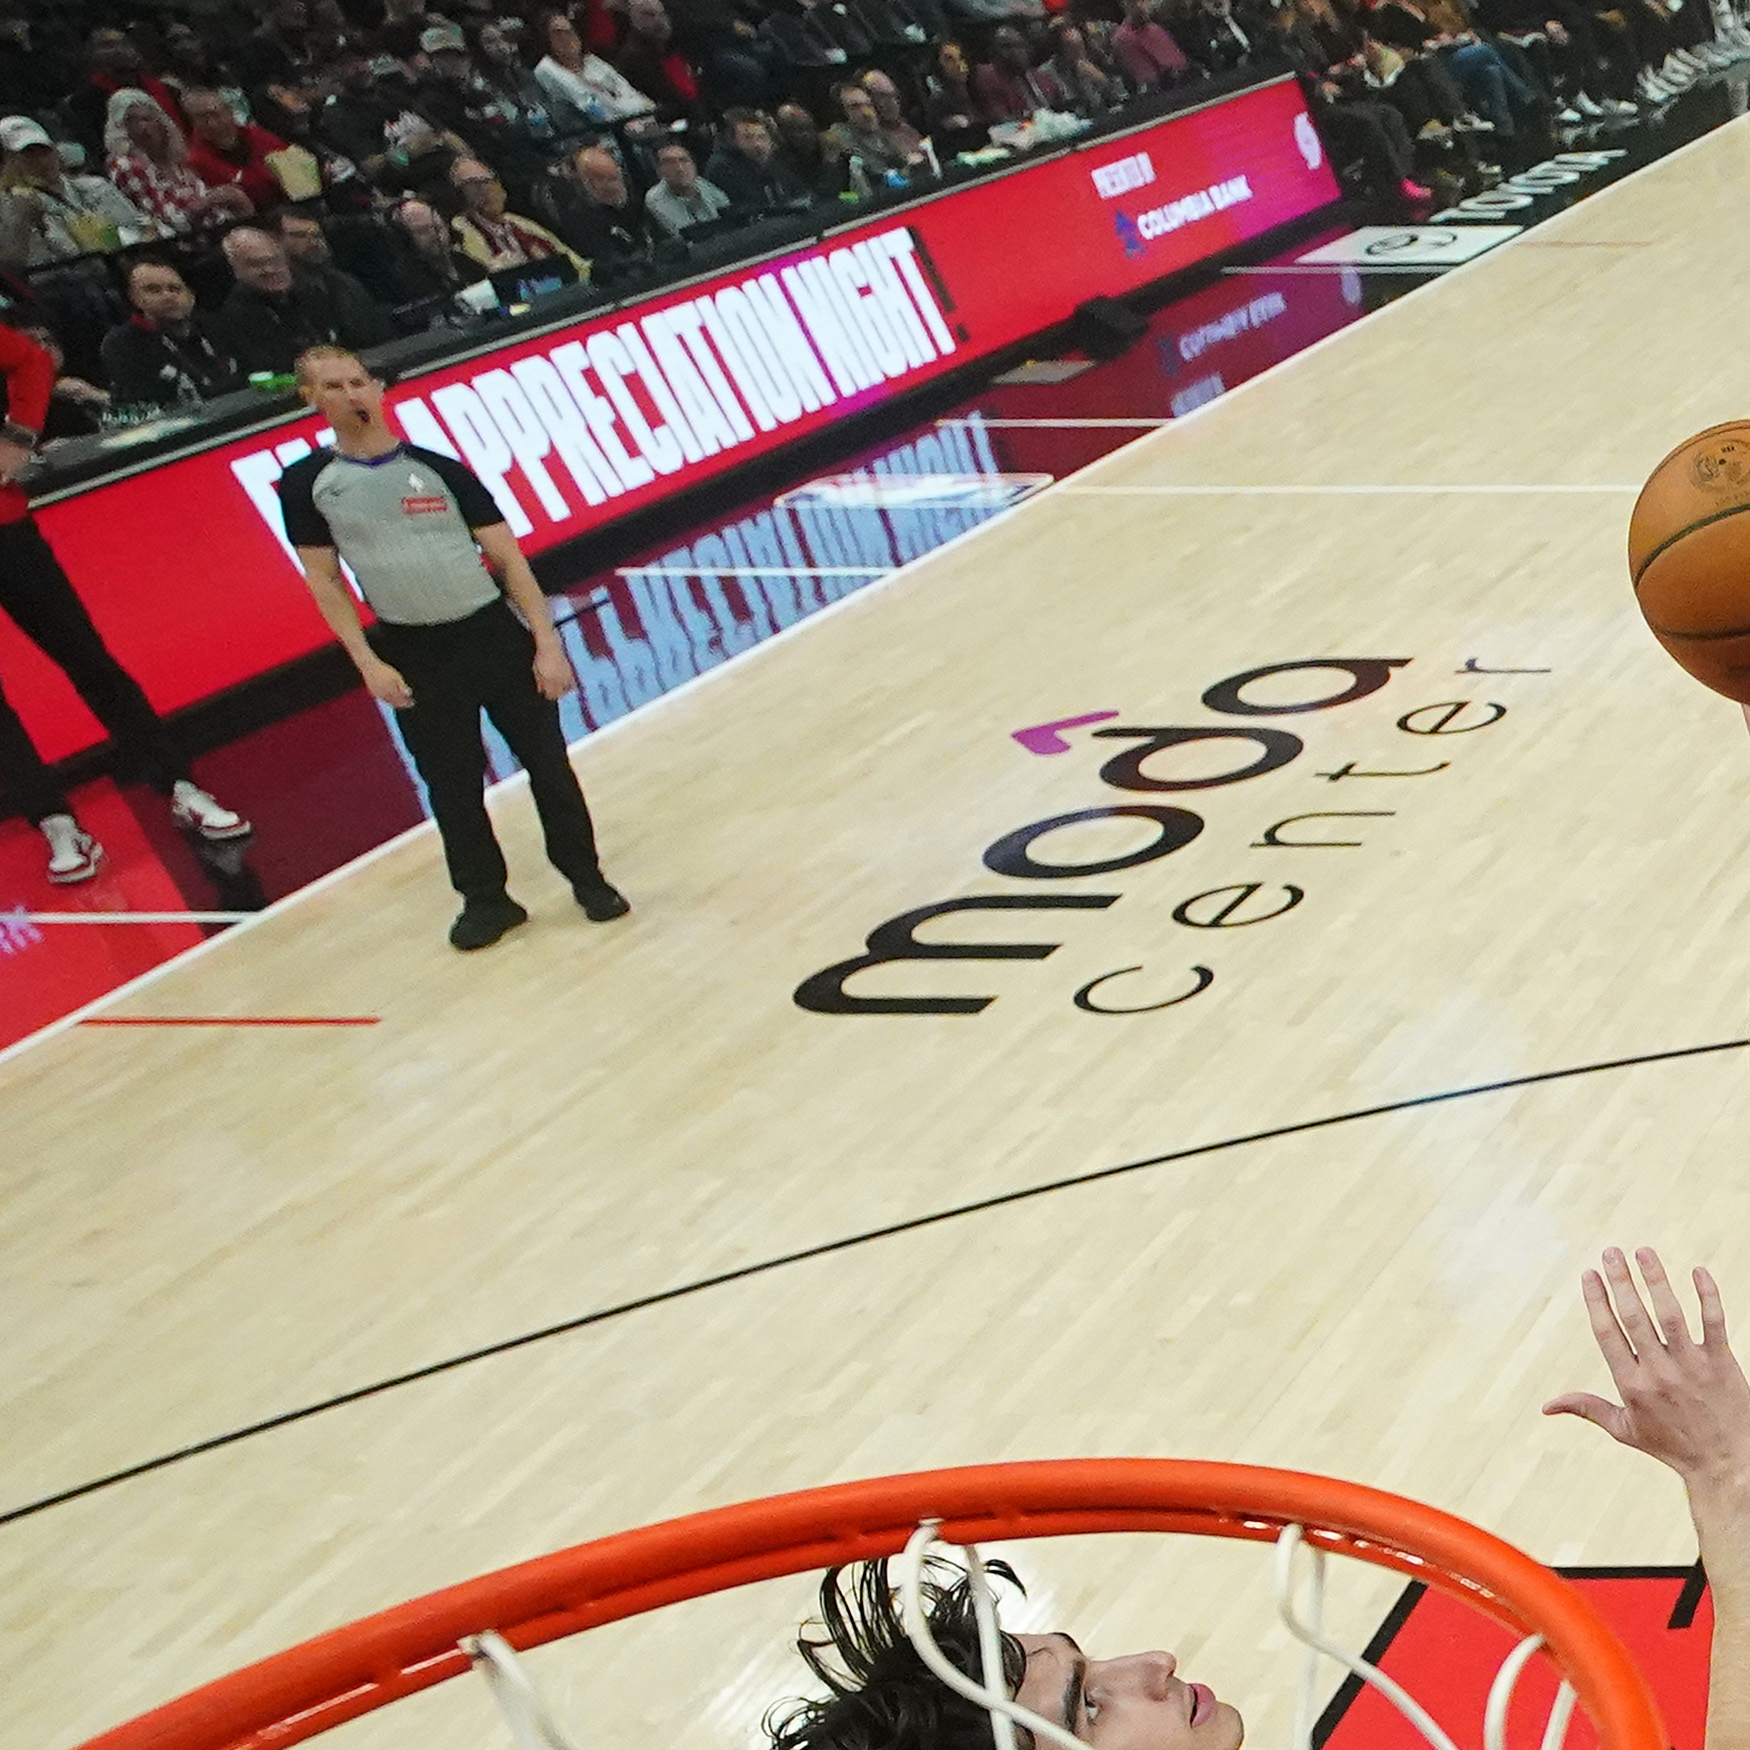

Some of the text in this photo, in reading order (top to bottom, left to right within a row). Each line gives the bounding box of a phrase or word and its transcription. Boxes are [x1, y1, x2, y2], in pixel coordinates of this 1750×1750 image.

[1430, 149, 1628, 223] TOYOTA
[793, 656, 1415, 1016] moda
[1073, 656, 1552, 1015] center
